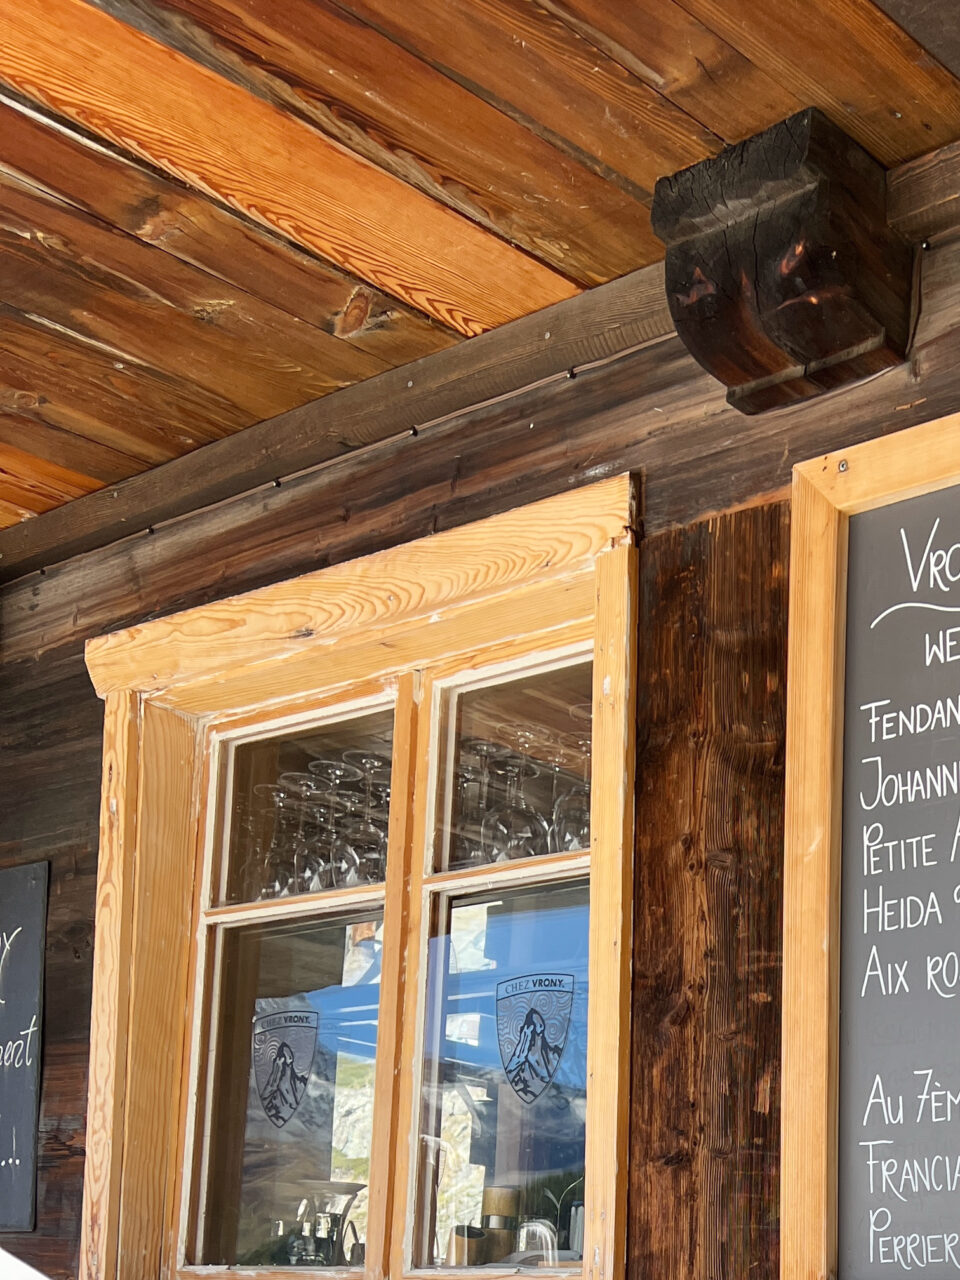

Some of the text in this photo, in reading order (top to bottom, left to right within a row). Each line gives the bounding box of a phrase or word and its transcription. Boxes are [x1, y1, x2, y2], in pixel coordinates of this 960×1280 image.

[862, 822, 938, 877] PETITE
[863, 885, 943, 935] HEIDA
[505, 980, 530, 994] CHEZ
[860, 944, 910, 998] AIX
